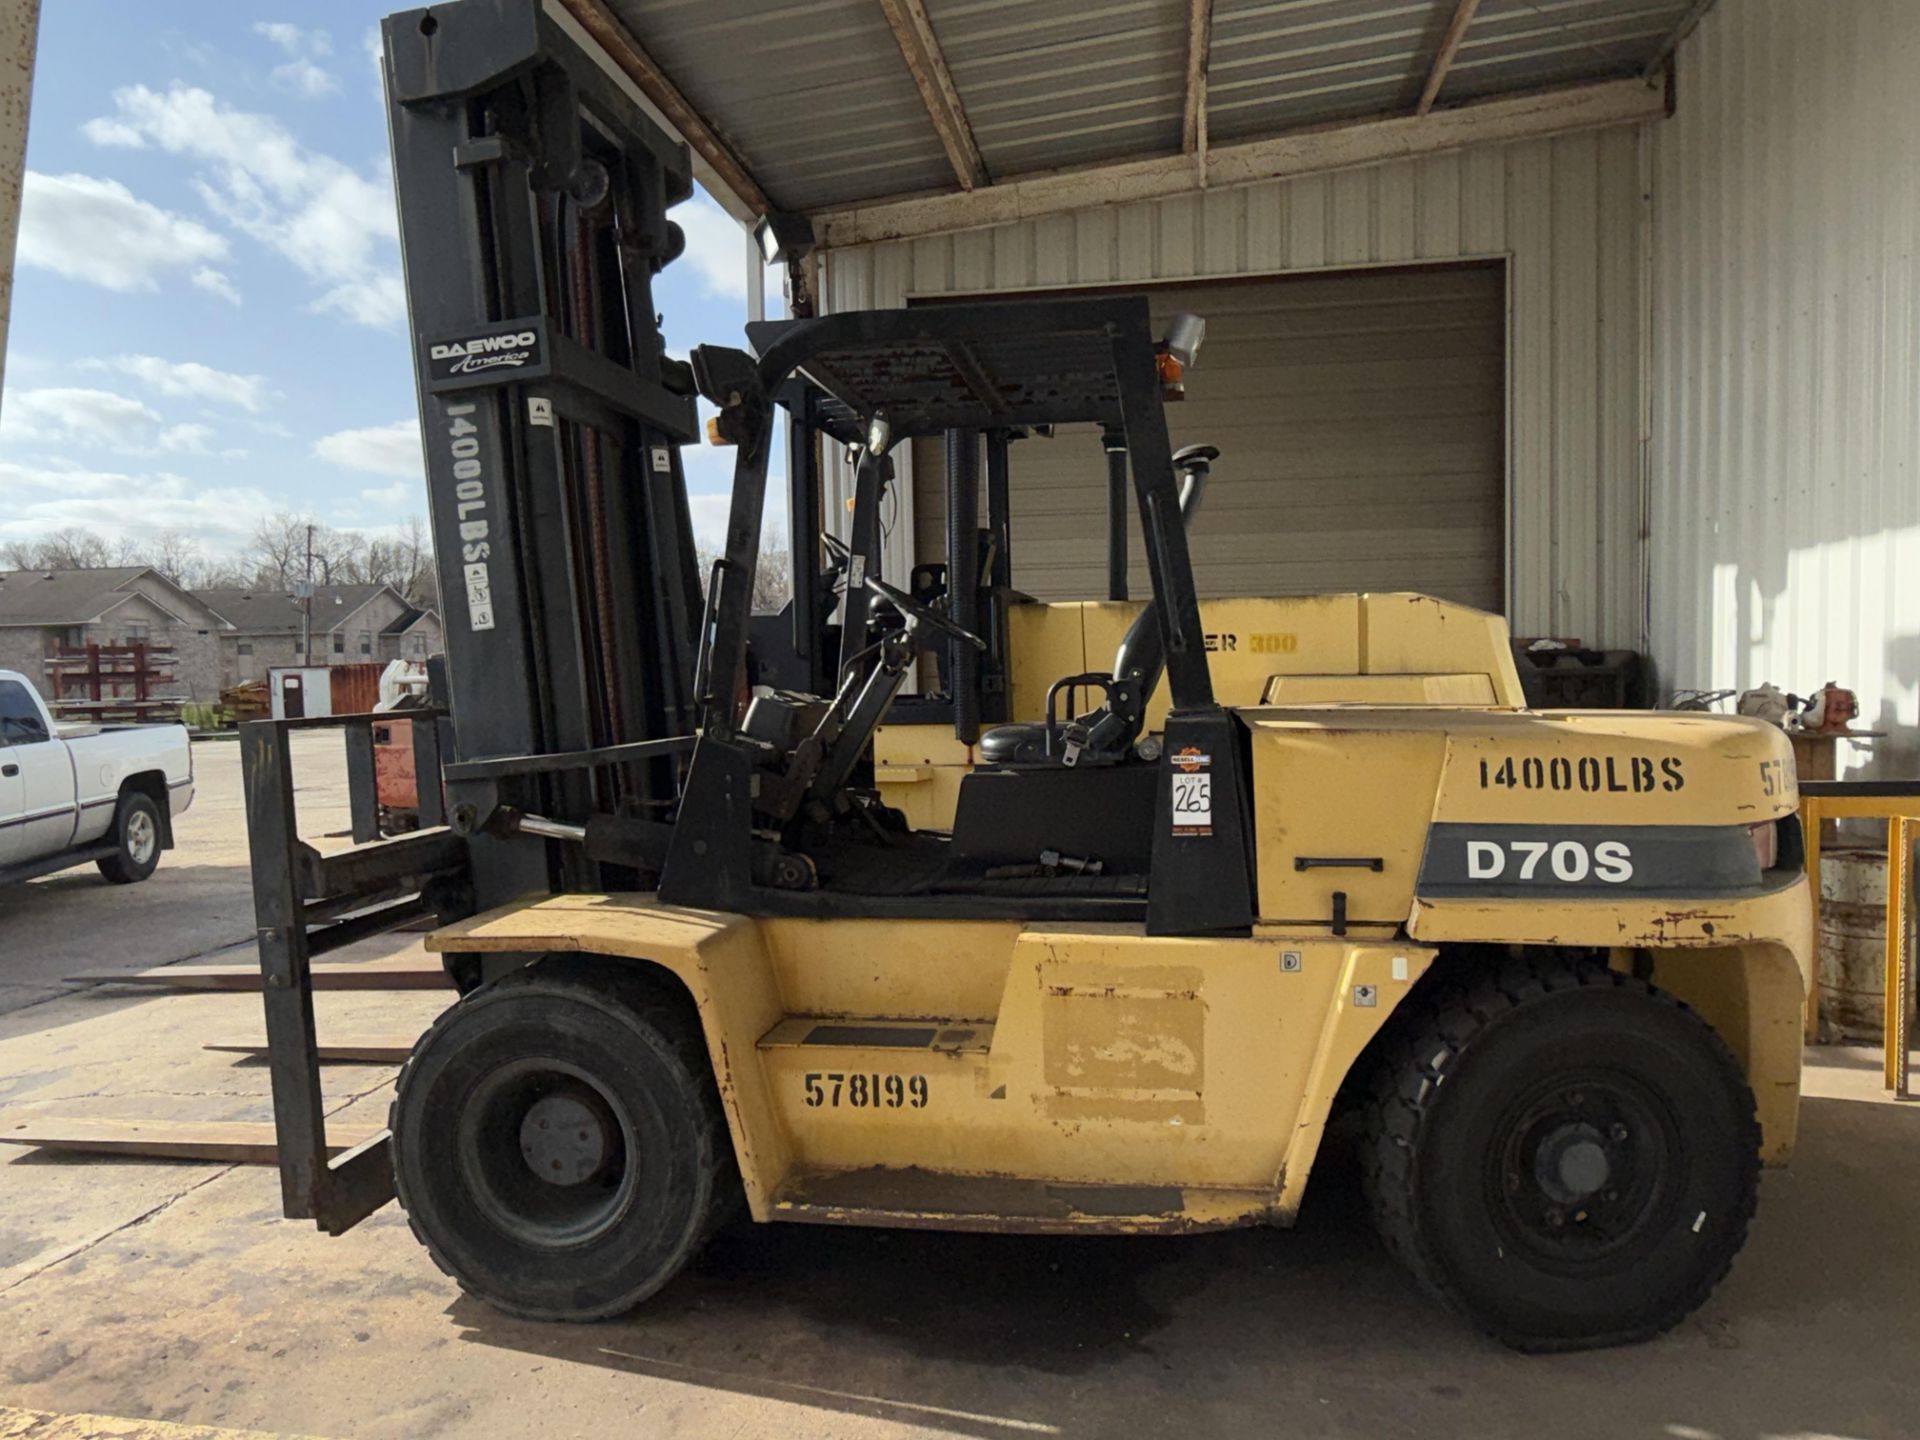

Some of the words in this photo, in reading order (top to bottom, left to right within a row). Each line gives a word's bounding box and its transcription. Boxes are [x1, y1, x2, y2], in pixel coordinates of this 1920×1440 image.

[430, 331, 536, 360] DAEWOO
[449, 351, 530, 373] America
[446, 404, 490, 562] 14000LBS
[1205, 634, 1237, 651] ER
[1179, 776, 1196, 785] LOT
[1479, 756, 1685, 793] 14000LBS
[1174, 783, 1211, 813] 265
[1466, 840, 1634, 883] D70S
[805, 1073, 928, 1108] 578199
